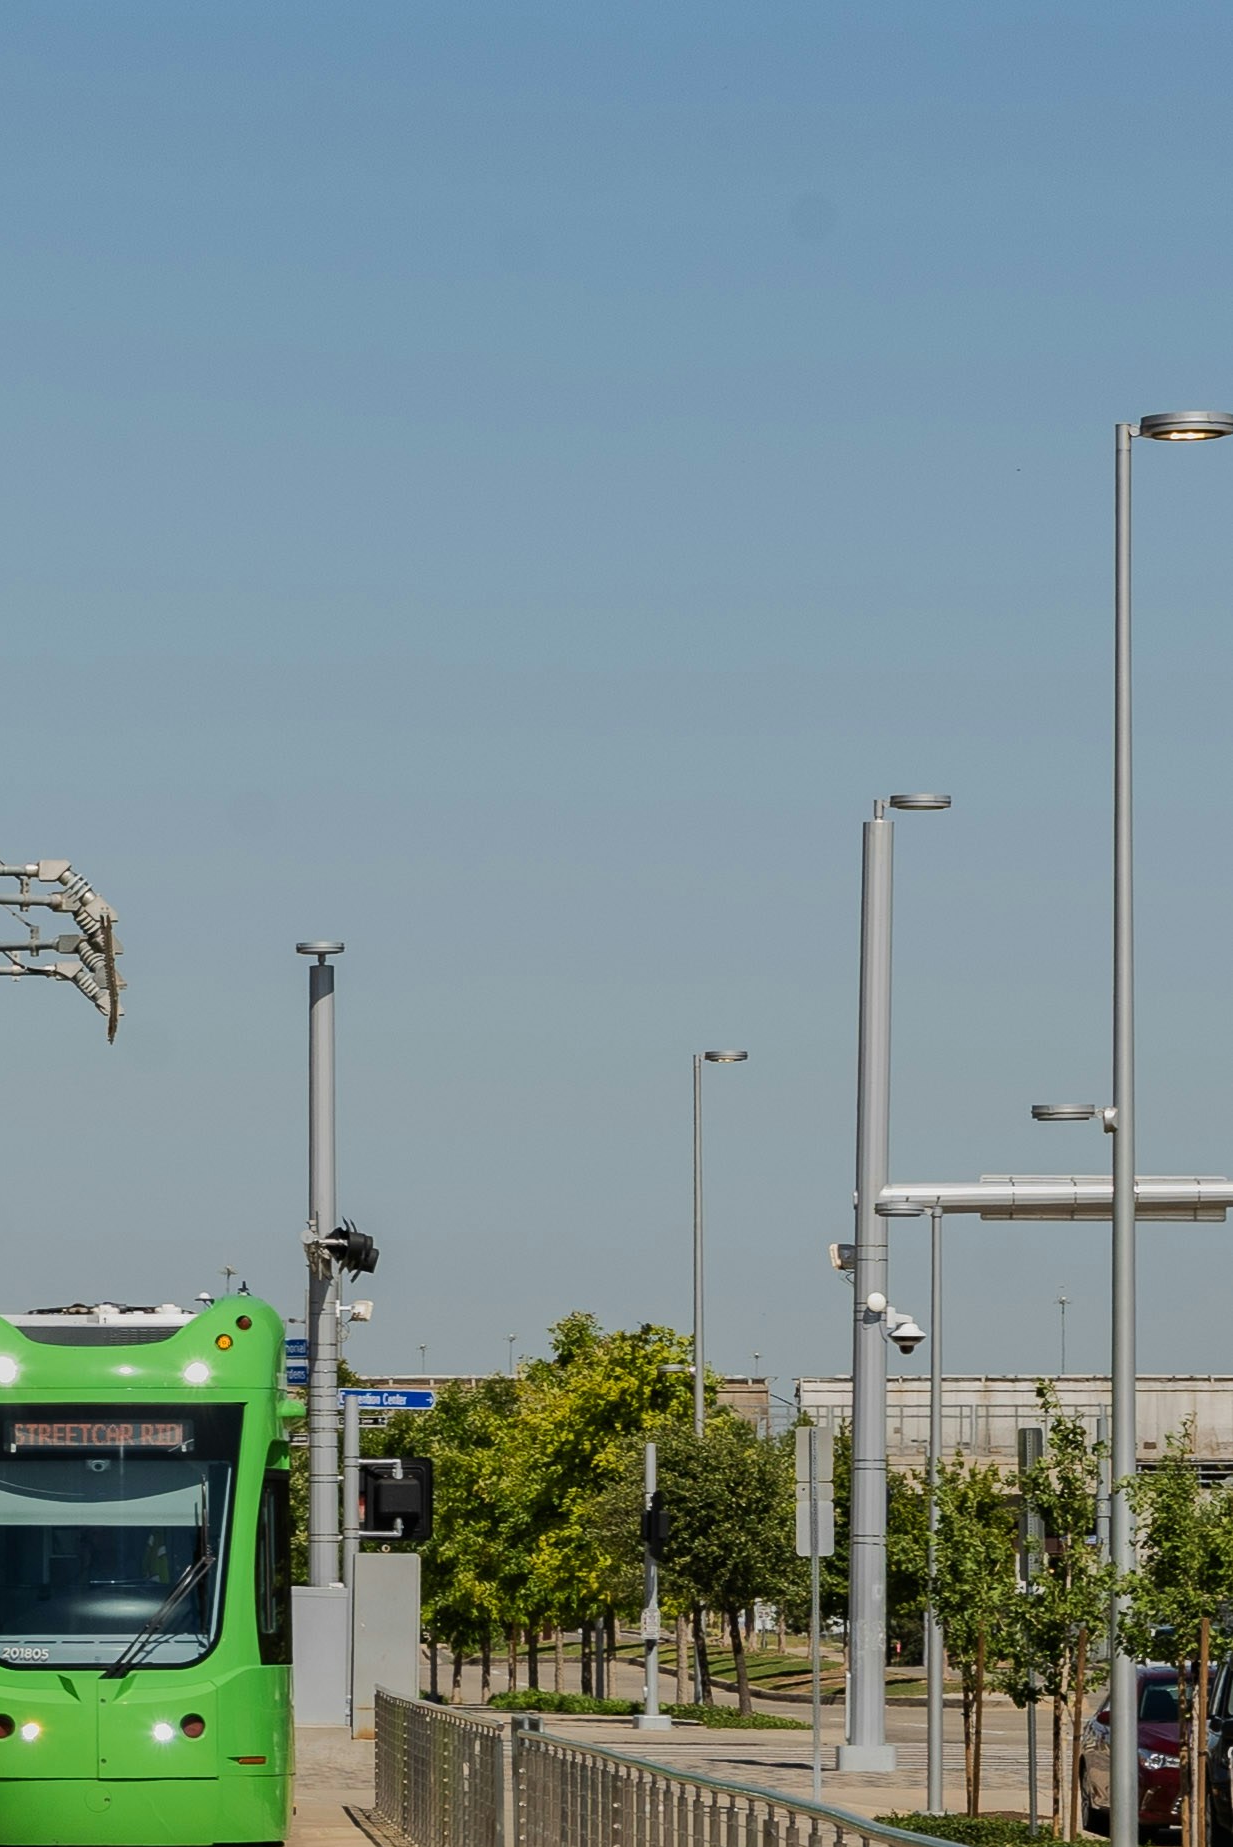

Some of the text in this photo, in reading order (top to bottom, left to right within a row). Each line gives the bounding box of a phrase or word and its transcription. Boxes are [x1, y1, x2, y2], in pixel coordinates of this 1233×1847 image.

[382, 1392, 407, 1406] Center
[14, 1423, 183, 1446] STREETCAR RID
[2, 1647, 50, 1660] 201805
